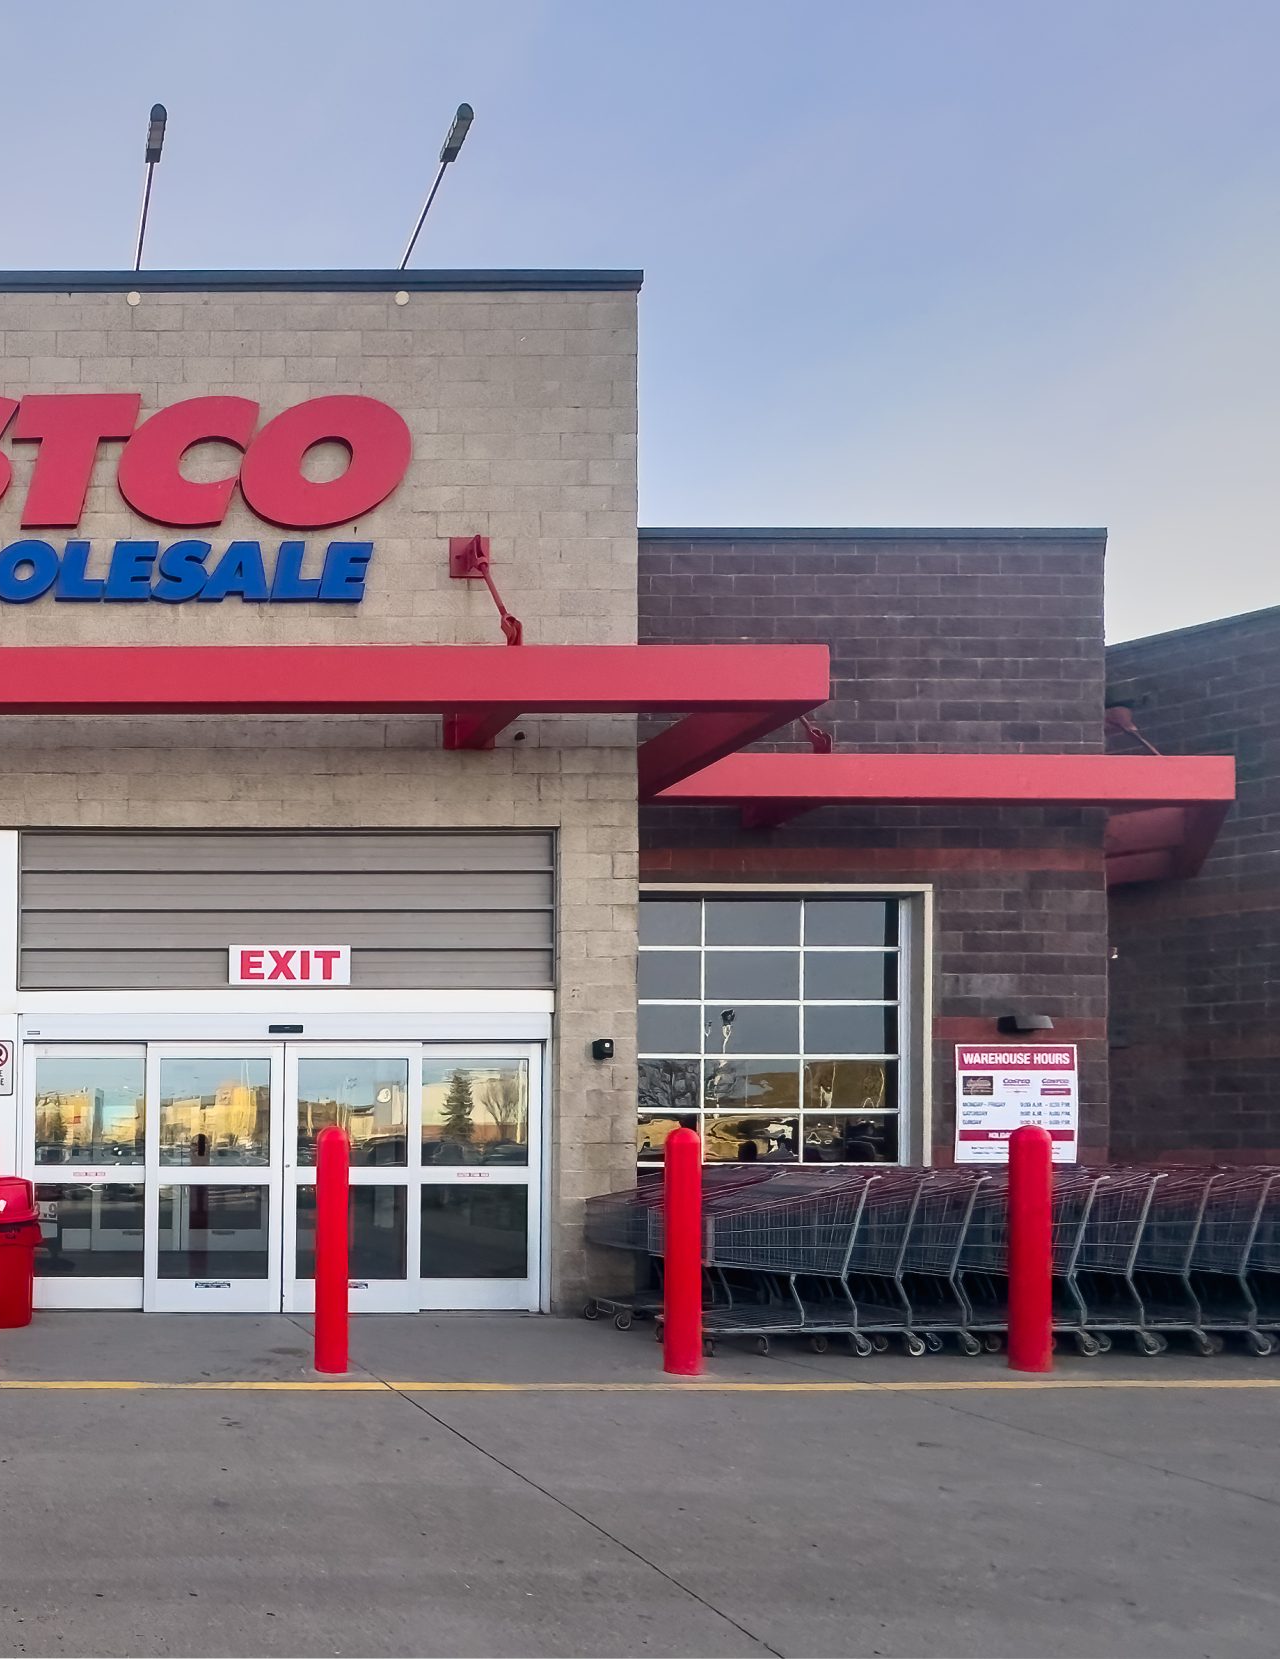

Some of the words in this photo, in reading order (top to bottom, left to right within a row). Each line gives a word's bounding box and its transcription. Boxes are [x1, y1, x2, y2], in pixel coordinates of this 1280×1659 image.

[240, 950, 341, 981] EXIT
[962, 1052, 1031, 1065] WAREHOUSE
[1033, 1052, 1070, 1065] HOURS
